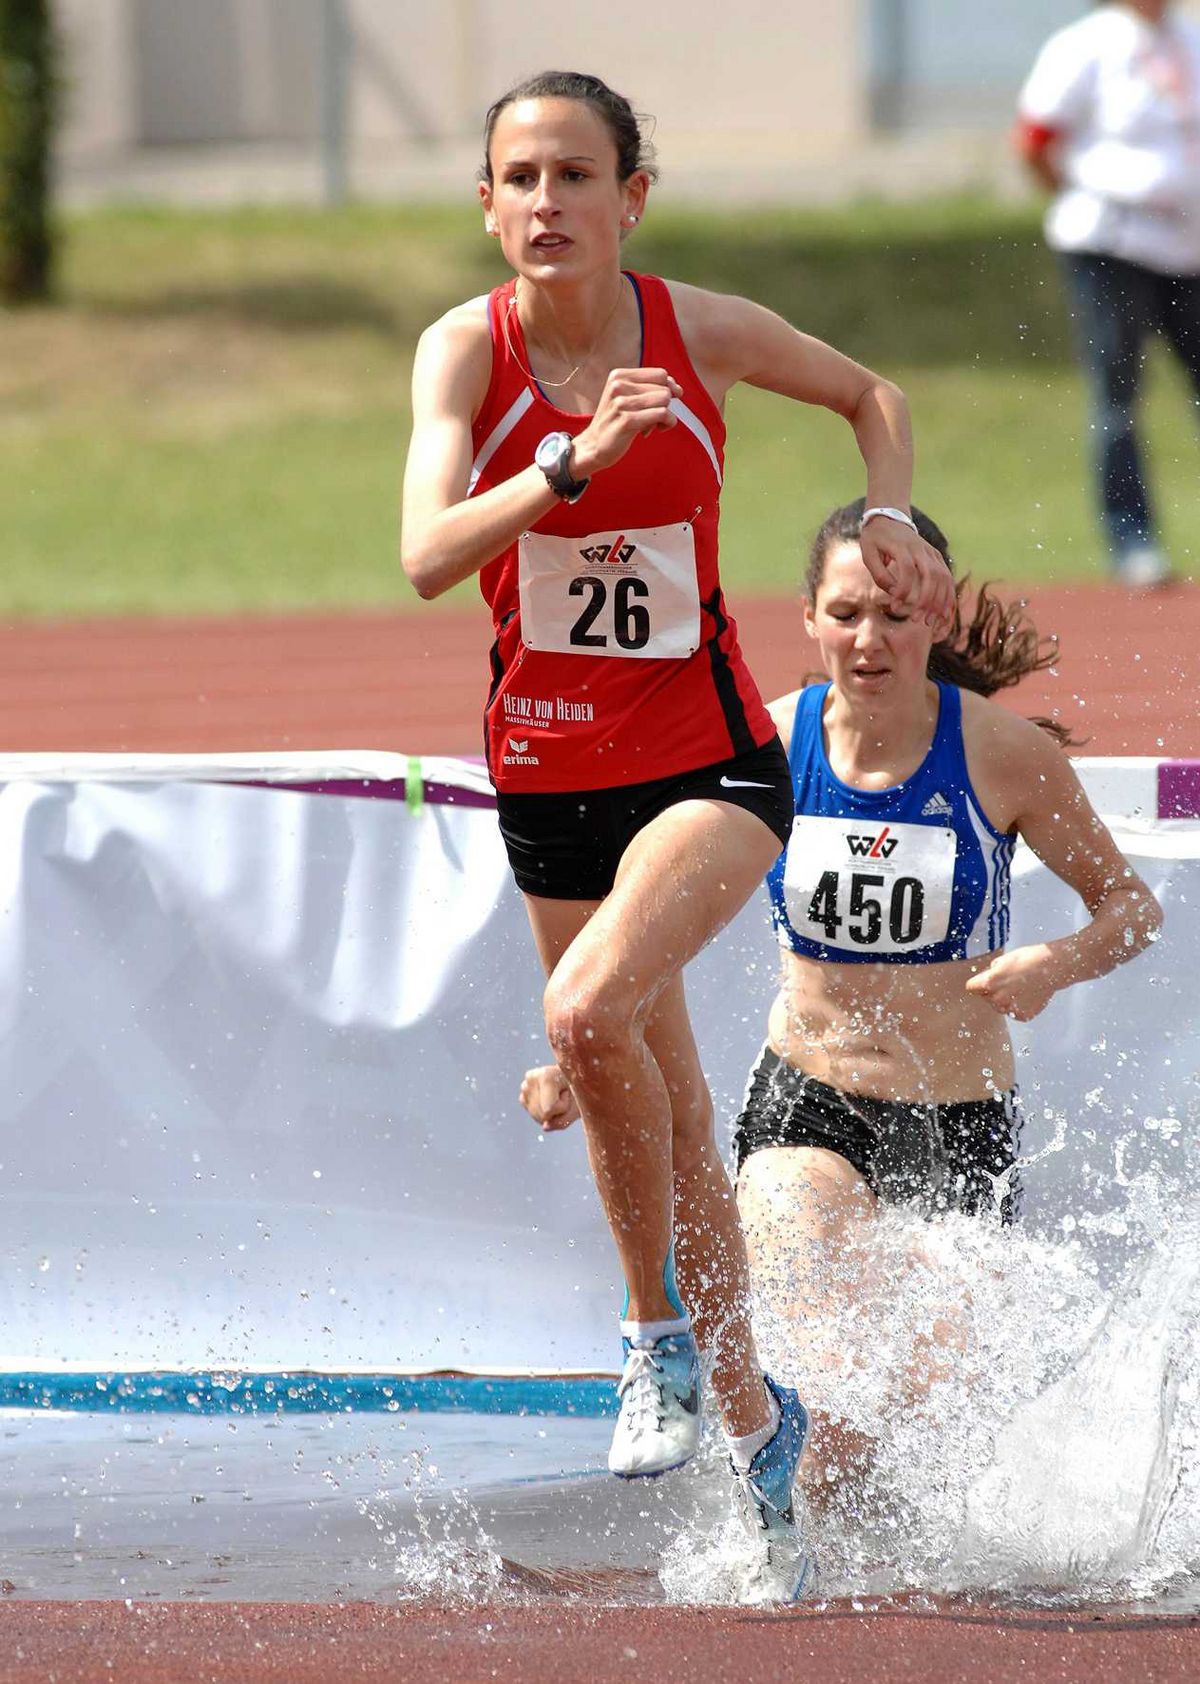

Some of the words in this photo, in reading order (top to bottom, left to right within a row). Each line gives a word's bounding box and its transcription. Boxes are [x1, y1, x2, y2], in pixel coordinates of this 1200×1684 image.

[568, 576, 651, 650] 26
[503, 693, 532, 717] HEINZ
[535, 699, 553, 720] VON
[556, 697, 594, 722] HEIDEN
[503, 754, 540, 766] erima
[921, 804, 953, 816] adidas
[807, 870, 924, 944] 450
